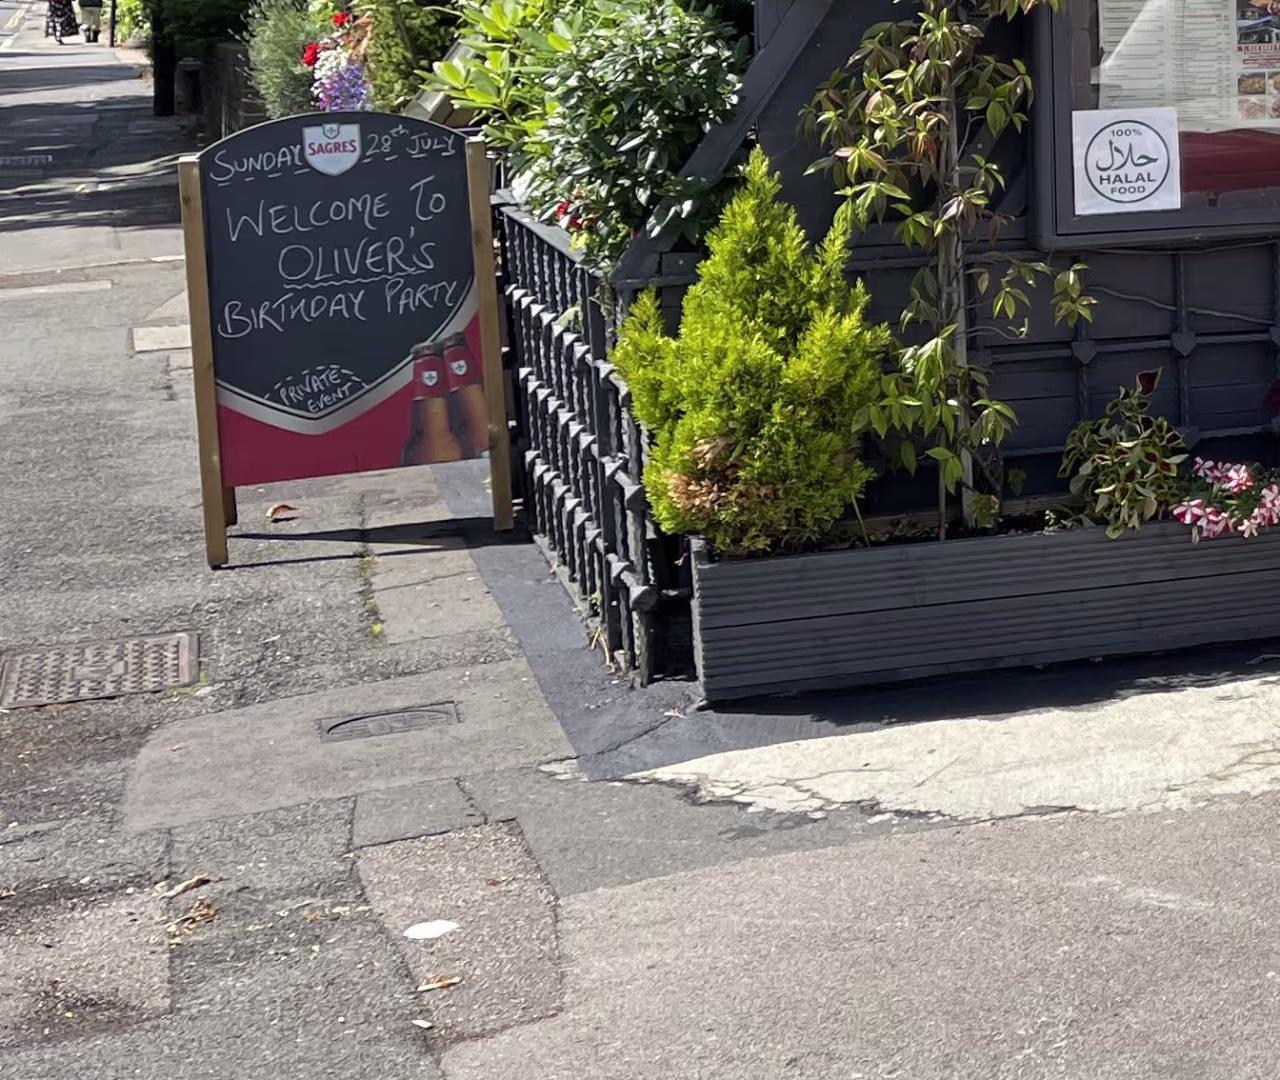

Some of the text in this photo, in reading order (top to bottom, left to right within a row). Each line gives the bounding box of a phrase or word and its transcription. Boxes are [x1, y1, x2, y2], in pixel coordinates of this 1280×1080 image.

[1111, 128, 1142, 137] 100%
[307, 139, 358, 156] SAGRES
[1095, 138, 1159, 172] حلال
[1099, 172, 1157, 185] HALAL
[1110, 185, 1146, 195] FOOD
[226, 193, 390, 242] WELCOME
[280, 368, 342, 407] PRIVATE
[307, 381, 352, 413] EVENT
